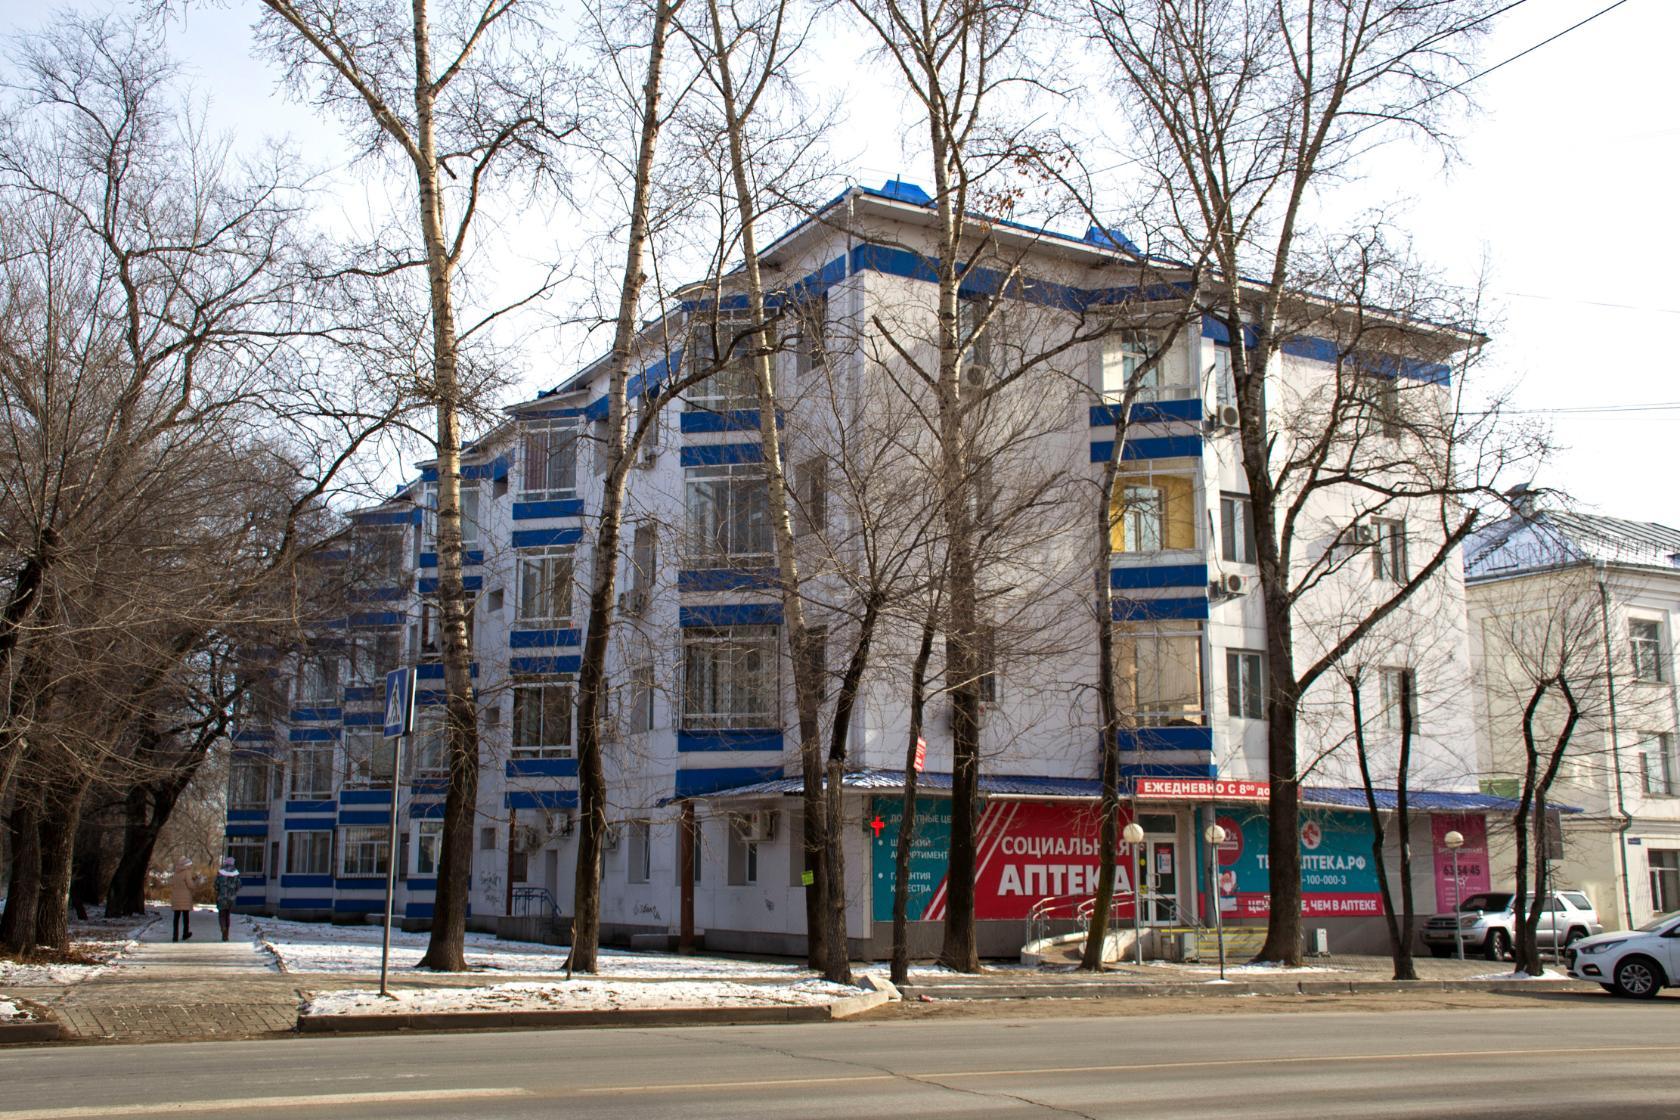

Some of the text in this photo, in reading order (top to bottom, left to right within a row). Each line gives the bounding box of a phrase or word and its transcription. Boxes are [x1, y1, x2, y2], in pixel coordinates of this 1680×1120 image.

[1144, 781, 1224, 794] ЕЖЕДНЕВНО
[1228, 785, 1236, 793] С
[1001, 837, 1131, 858] СОЦИАЛЬНЯ
[997, 864, 1132, 896] АПТЕКА
[890, 884, 932, 893] КЕСТВА
[1311, 900, 1331, 910] ЧЕМ
[1333, 900, 1339, 910] В
[1341, 900, 1376, 911] АПТЕКЕ
